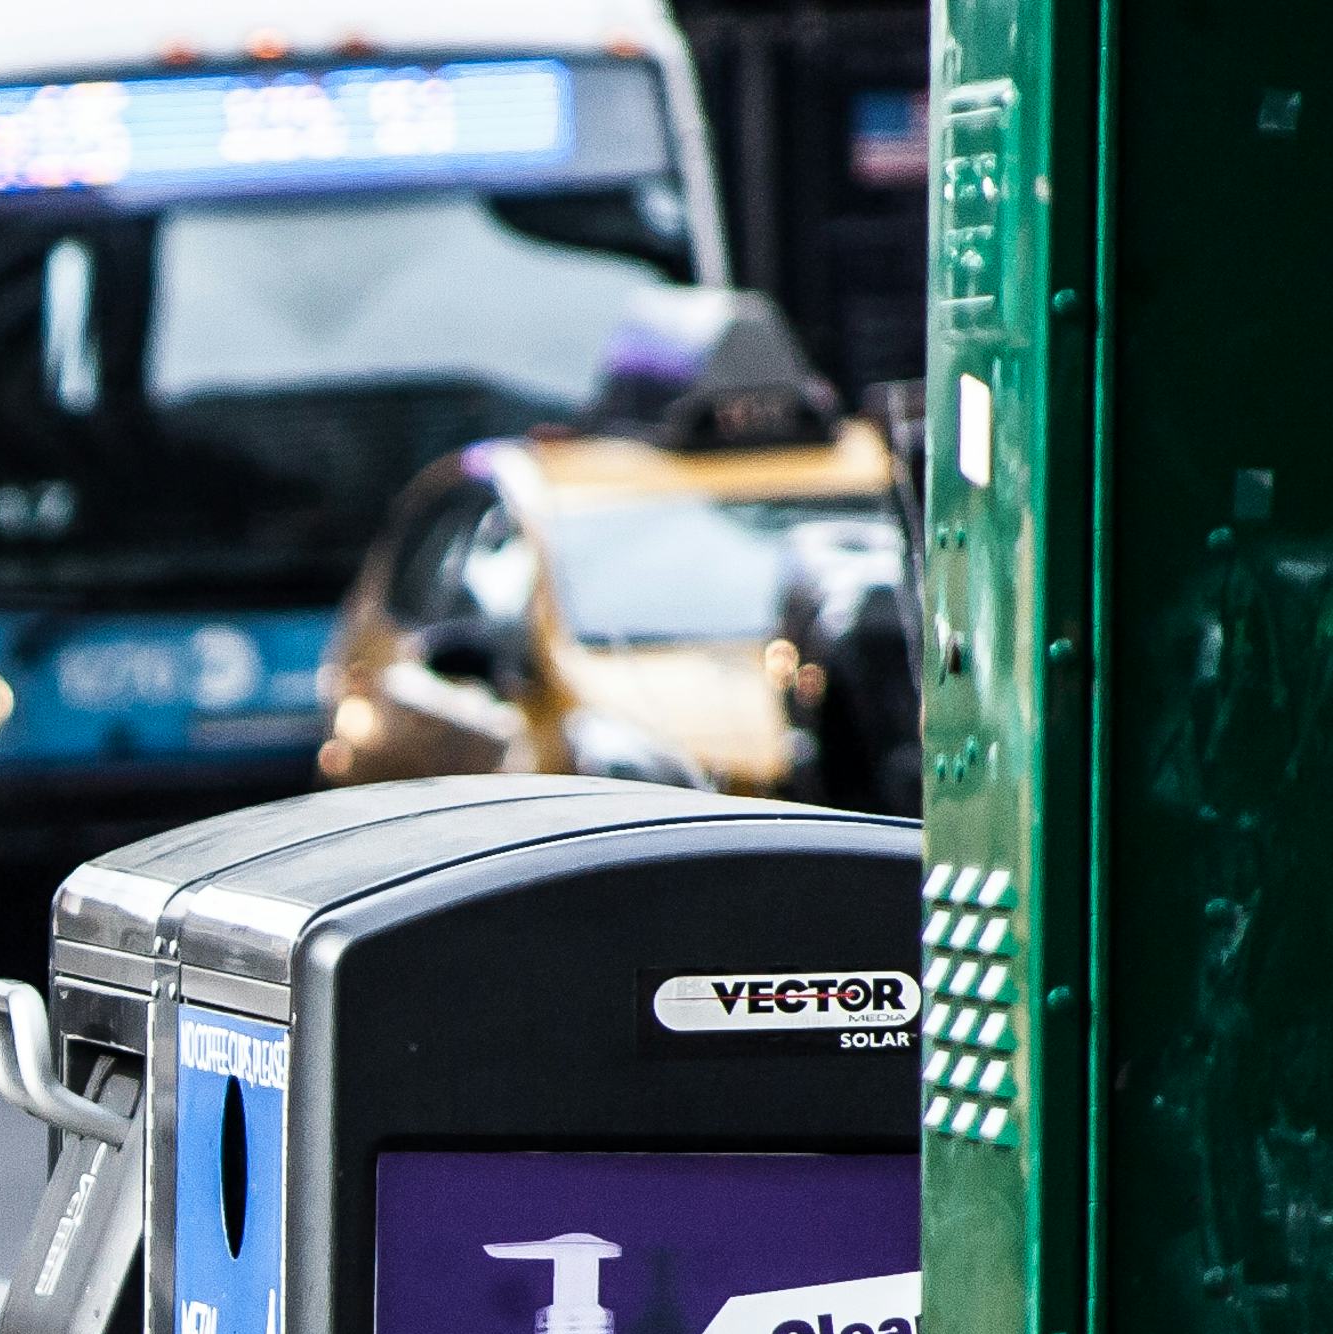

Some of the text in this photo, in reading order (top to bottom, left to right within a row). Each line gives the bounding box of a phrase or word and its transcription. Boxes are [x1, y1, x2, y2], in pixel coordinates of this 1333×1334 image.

[711, 977, 907, 1015] VECTOR
[848, 1013, 907, 1022] MEDIA
[840, 1032, 910, 1048] SOLAR
